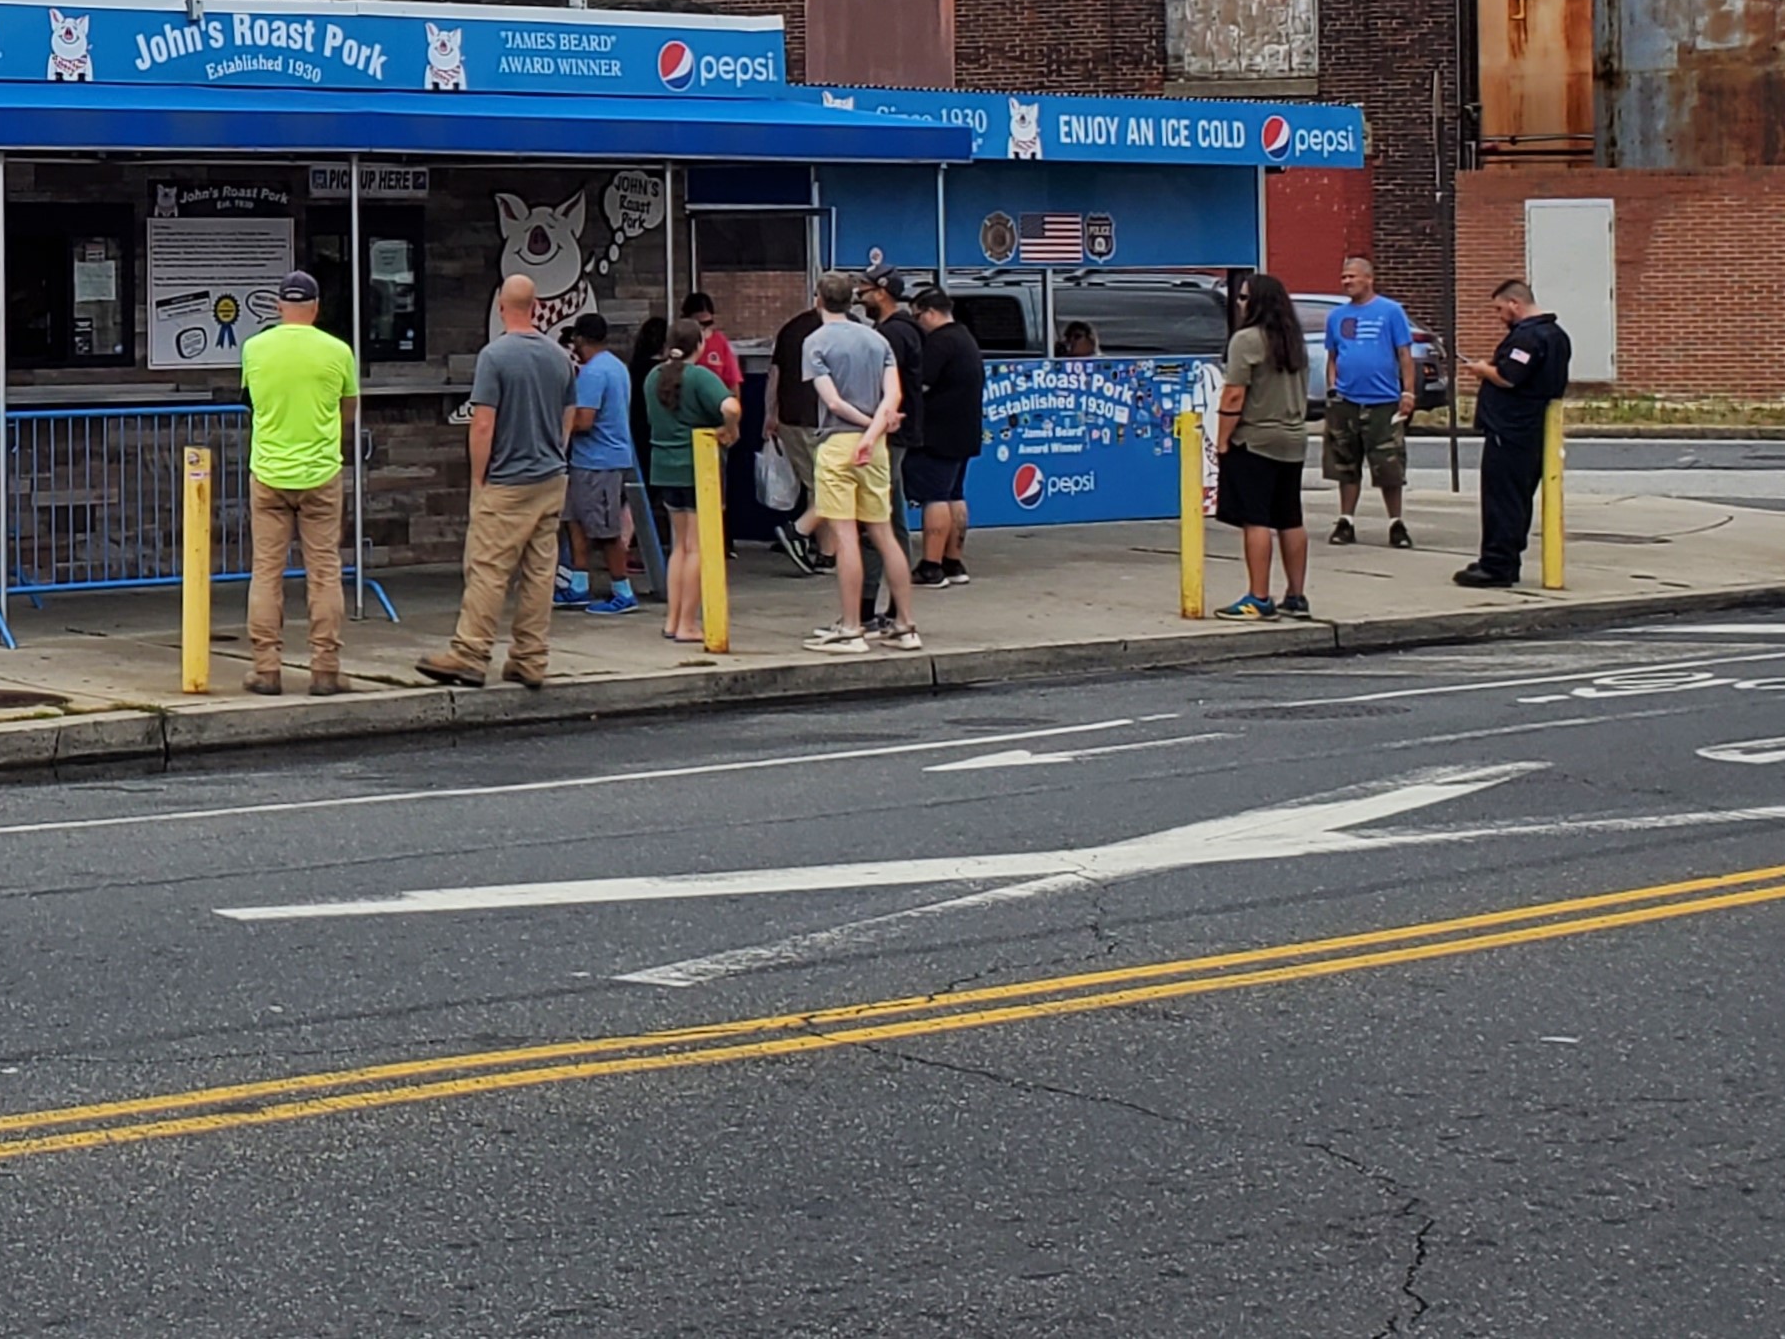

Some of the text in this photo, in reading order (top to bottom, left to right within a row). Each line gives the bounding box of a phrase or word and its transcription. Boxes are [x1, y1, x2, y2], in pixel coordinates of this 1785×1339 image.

[135, 13, 388, 80] John's Roast Pork
[500, 31, 616, 52] "JAMES BEARD"
[205, 54, 322, 83] Established 1930
[498, 56, 622, 77] AWARD WINNER
[700, 52, 774, 87] pepsi
[940, 108, 987, 133] 1930
[1059, 115, 1245, 148] ENJOY AN ICE COLD
[1295, 126, 1352, 157] pepsi
[360, 170, 377, 190] UP
[378, 170, 410, 190] HERE
[614, 175, 659, 197] JOHN'S
[180, 185, 288, 204] John's Roast Pork
[622, 211, 646, 229] Pork
[1032, 369, 1087, 391] Roast
[1091, 374, 1134, 405] Pork
[1079, 394, 1114, 418] 1930
[1018, 442, 1083, 454] Award Winner
[1047, 471, 1095, 497] pepsi
